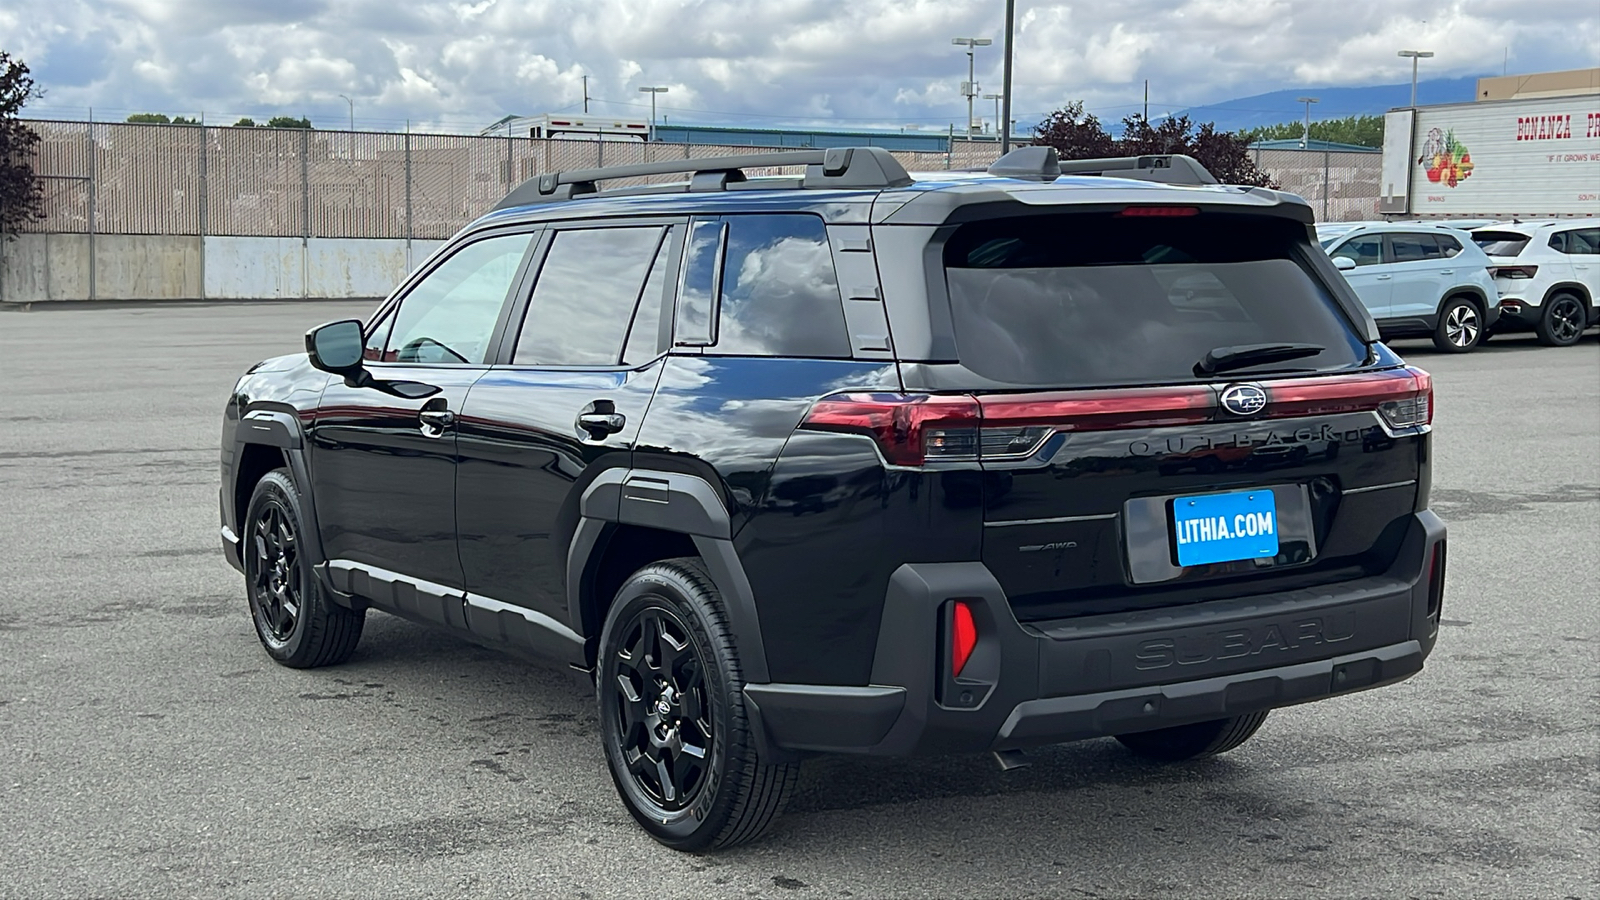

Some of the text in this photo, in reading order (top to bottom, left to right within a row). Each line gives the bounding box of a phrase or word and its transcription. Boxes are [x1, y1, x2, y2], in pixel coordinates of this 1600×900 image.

[1517, 114, 1571, 141] BONANZA
[1556, 154, 1562, 162] IT
[1564, 153, 1587, 162] GROWS
[1128, 426, 1338, 456] OUTBACK
[1177, 511, 1273, 545] LITHIA.COM
[1041, 541, 1078, 551] AWD
[1135, 611, 1358, 671] SUBARU
